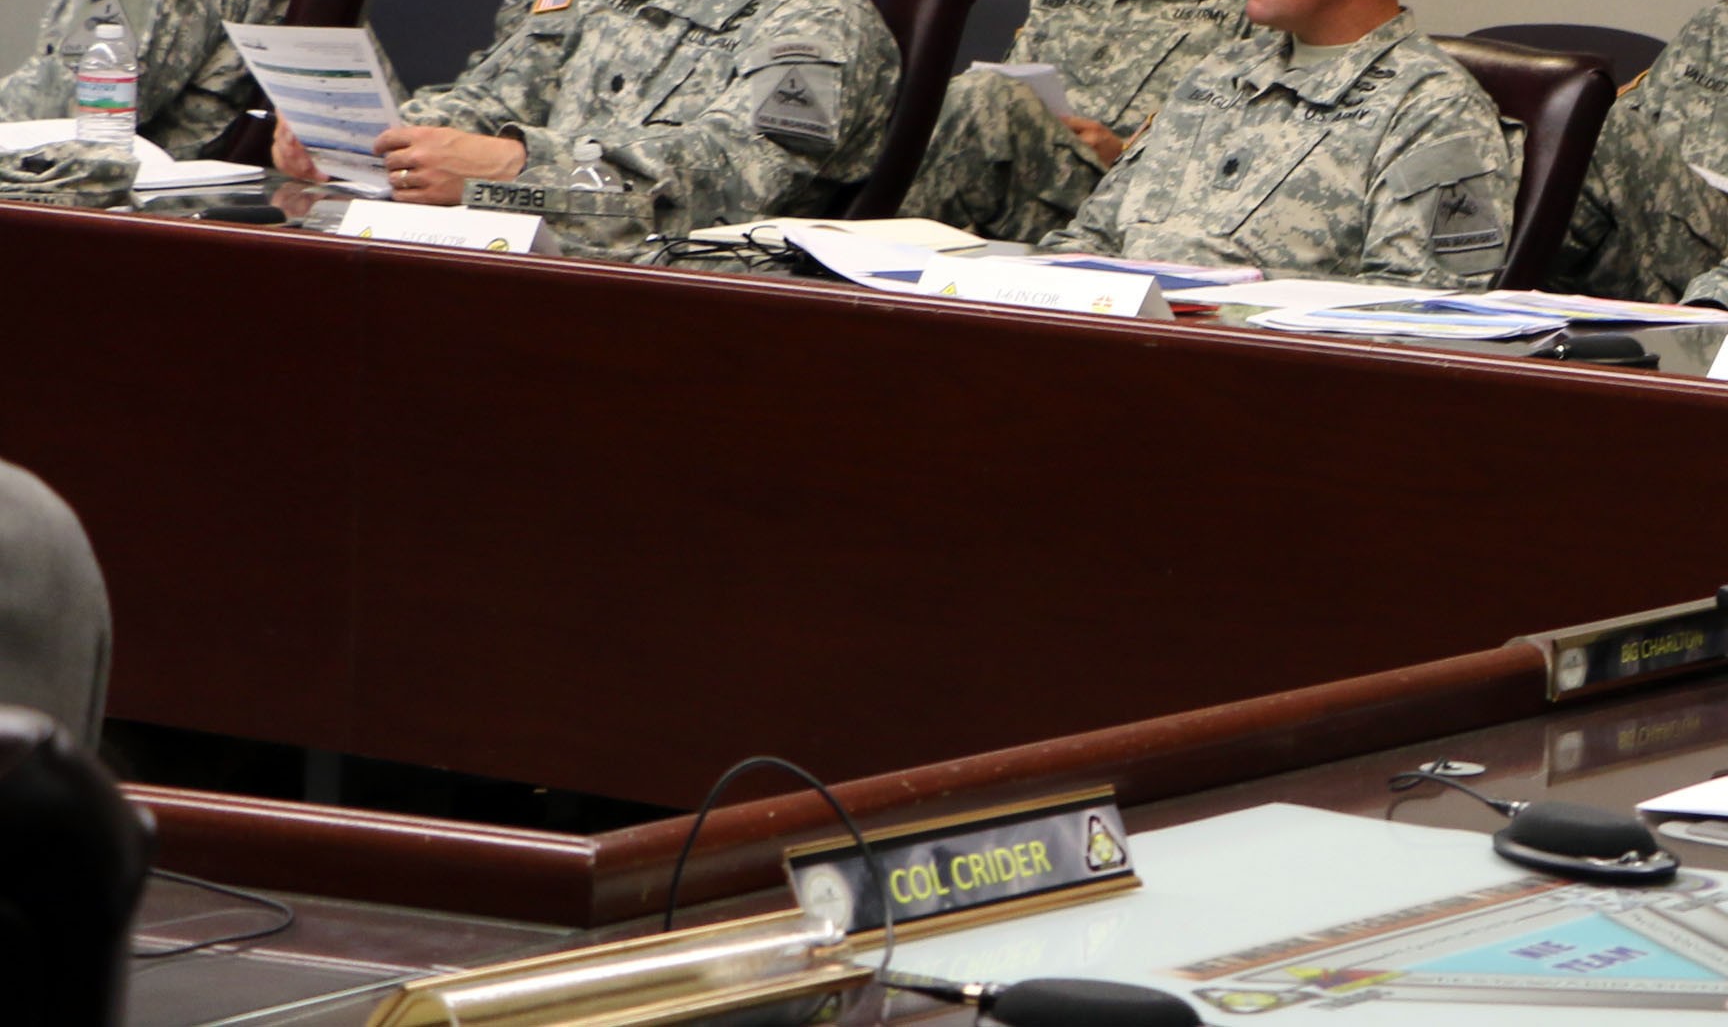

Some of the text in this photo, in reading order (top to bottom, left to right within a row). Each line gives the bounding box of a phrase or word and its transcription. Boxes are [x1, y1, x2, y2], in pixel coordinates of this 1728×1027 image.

[473, 183, 545, 207] BEAGLE
[1641, 629, 1705, 658] CHARLTON
[889, 840, 1053, 904] COL CRIDER
[1509, 940, 1576, 960] NIE
[1552, 946, 1649, 973] TEAM
